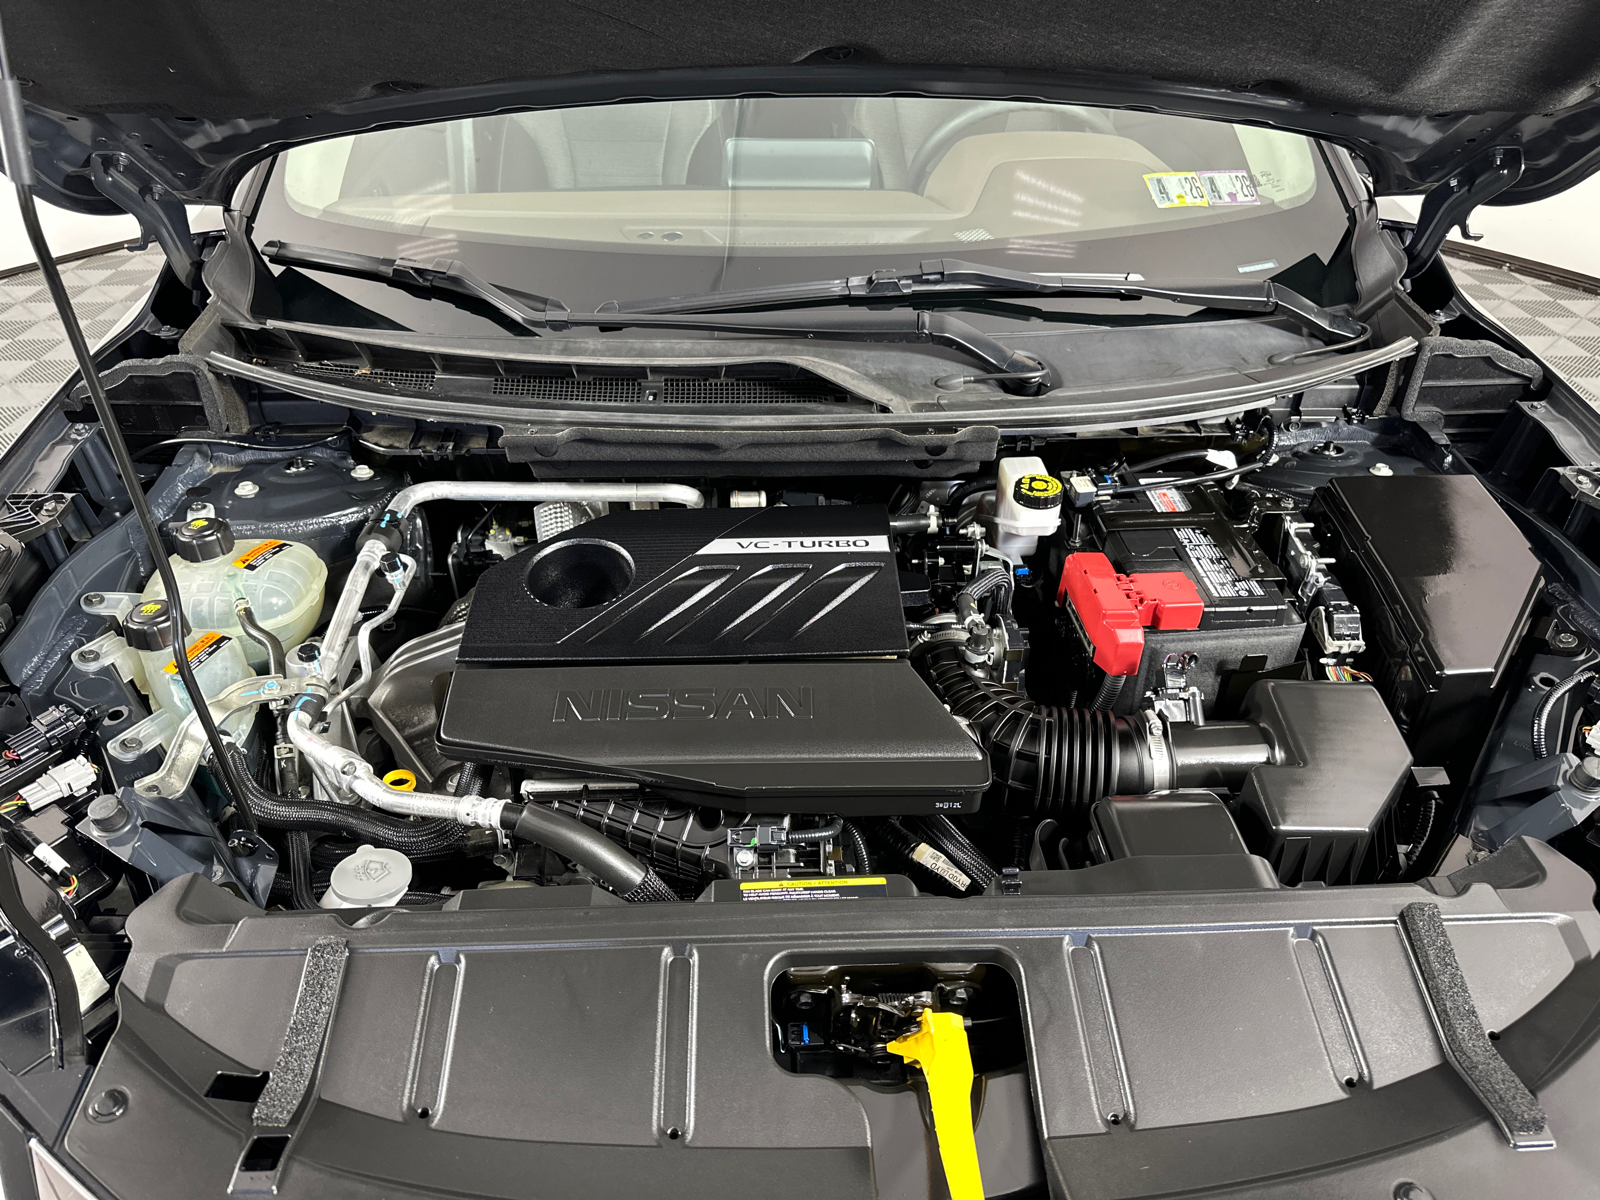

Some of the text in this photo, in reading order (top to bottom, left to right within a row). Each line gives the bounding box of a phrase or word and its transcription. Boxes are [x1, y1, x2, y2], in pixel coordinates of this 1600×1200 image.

[1155, 178, 1171, 202] 4
[1184, 176, 1205, 199] 26
[1207, 176, 1223, 200] 4
[1234, 174, 1255, 198] 26
[736, 538, 870, 549] VC-TURBO
[552, 686, 814, 722] NISSAN
